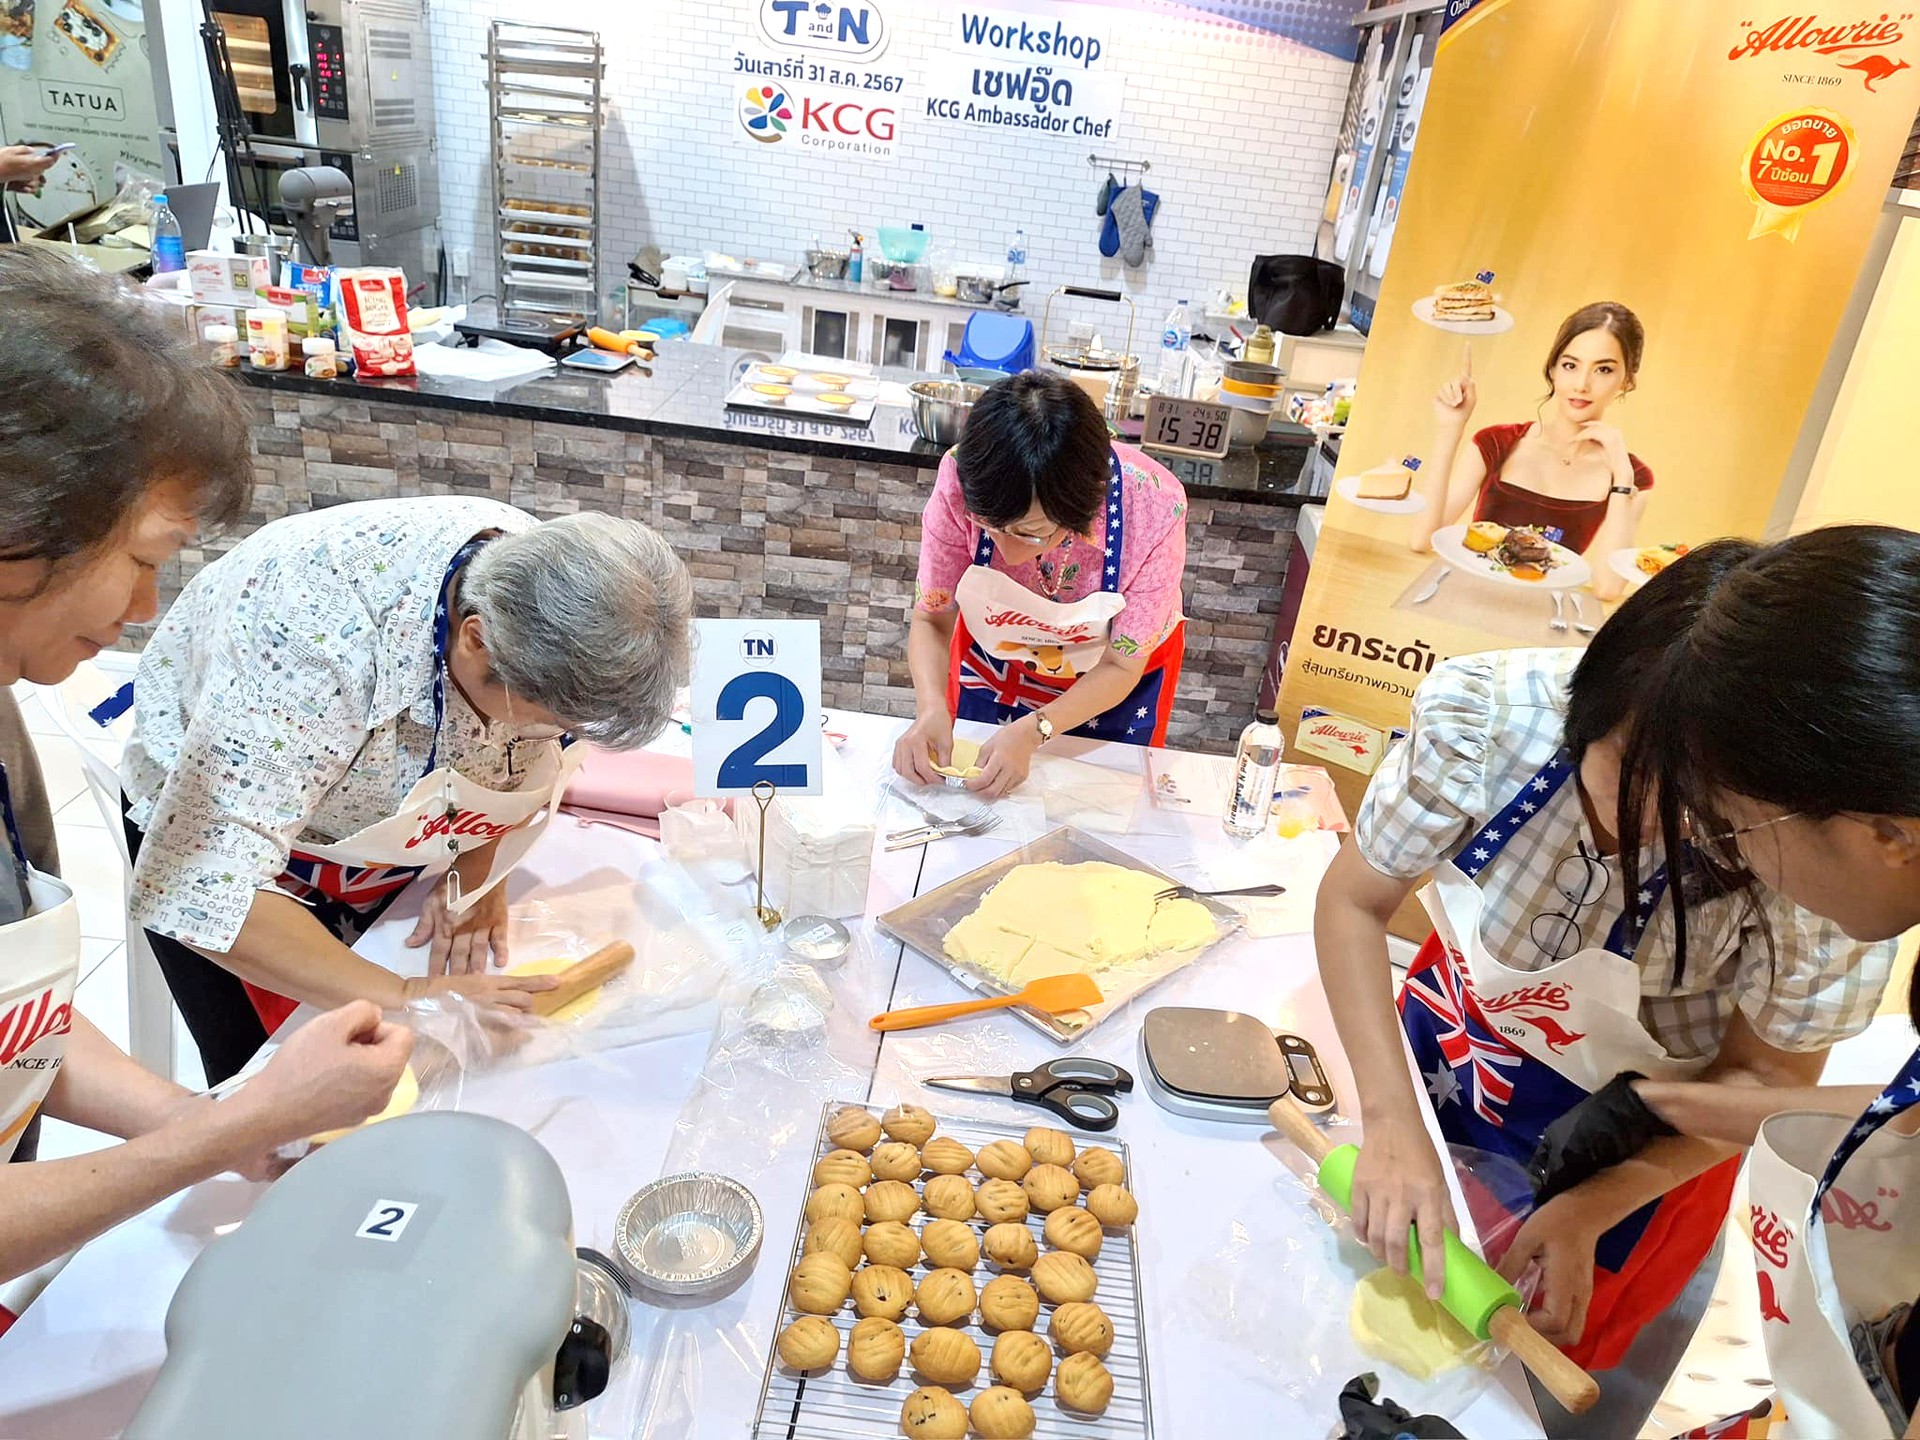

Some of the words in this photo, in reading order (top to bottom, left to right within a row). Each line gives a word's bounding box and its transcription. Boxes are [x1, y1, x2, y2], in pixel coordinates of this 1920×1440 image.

[772, 0, 809, 35] T
[808, 22, 833, 33] and
[837, 7, 869, 44] N
[962, 12, 1101, 69] Workshop
[734, 51, 804, 79] วันเสาร์ที่
[808, 64, 825, 82] 31
[829, 69, 859, 88] ส.ค.
[863, 73, 904, 94] 2567
[1781, 73, 1815, 85] SINCE
[1817, 75, 1842, 87] 1869
[48, 90, 117, 112] TATUA
[971, 66, 1073, 113] เชฟอู๊ด
[802, 97, 895, 140] KCG
[926, 97, 960, 119] KCG
[964, 102, 1069, 132] Ambassador
[1073, 116, 1112, 138] Chef
[1781, 118, 1838, 138] ยอดขาย
[801, 134, 890, 156] Corporation
[1761, 138, 1806, 163] No.
[1811, 141, 1842, 185] 1
[1756, 160, 1772, 179] 7
[1770, 167, 1809, 184] ปีซ้อน
[1158, 416, 1181, 443] 15
[1189, 420, 1223, 449] 38
[743, 639, 774, 656] TN
[716, 671, 808, 789] 2
[1499, 1025, 1526, 1038] 1869
[365, 1207, 405, 1236] 2
